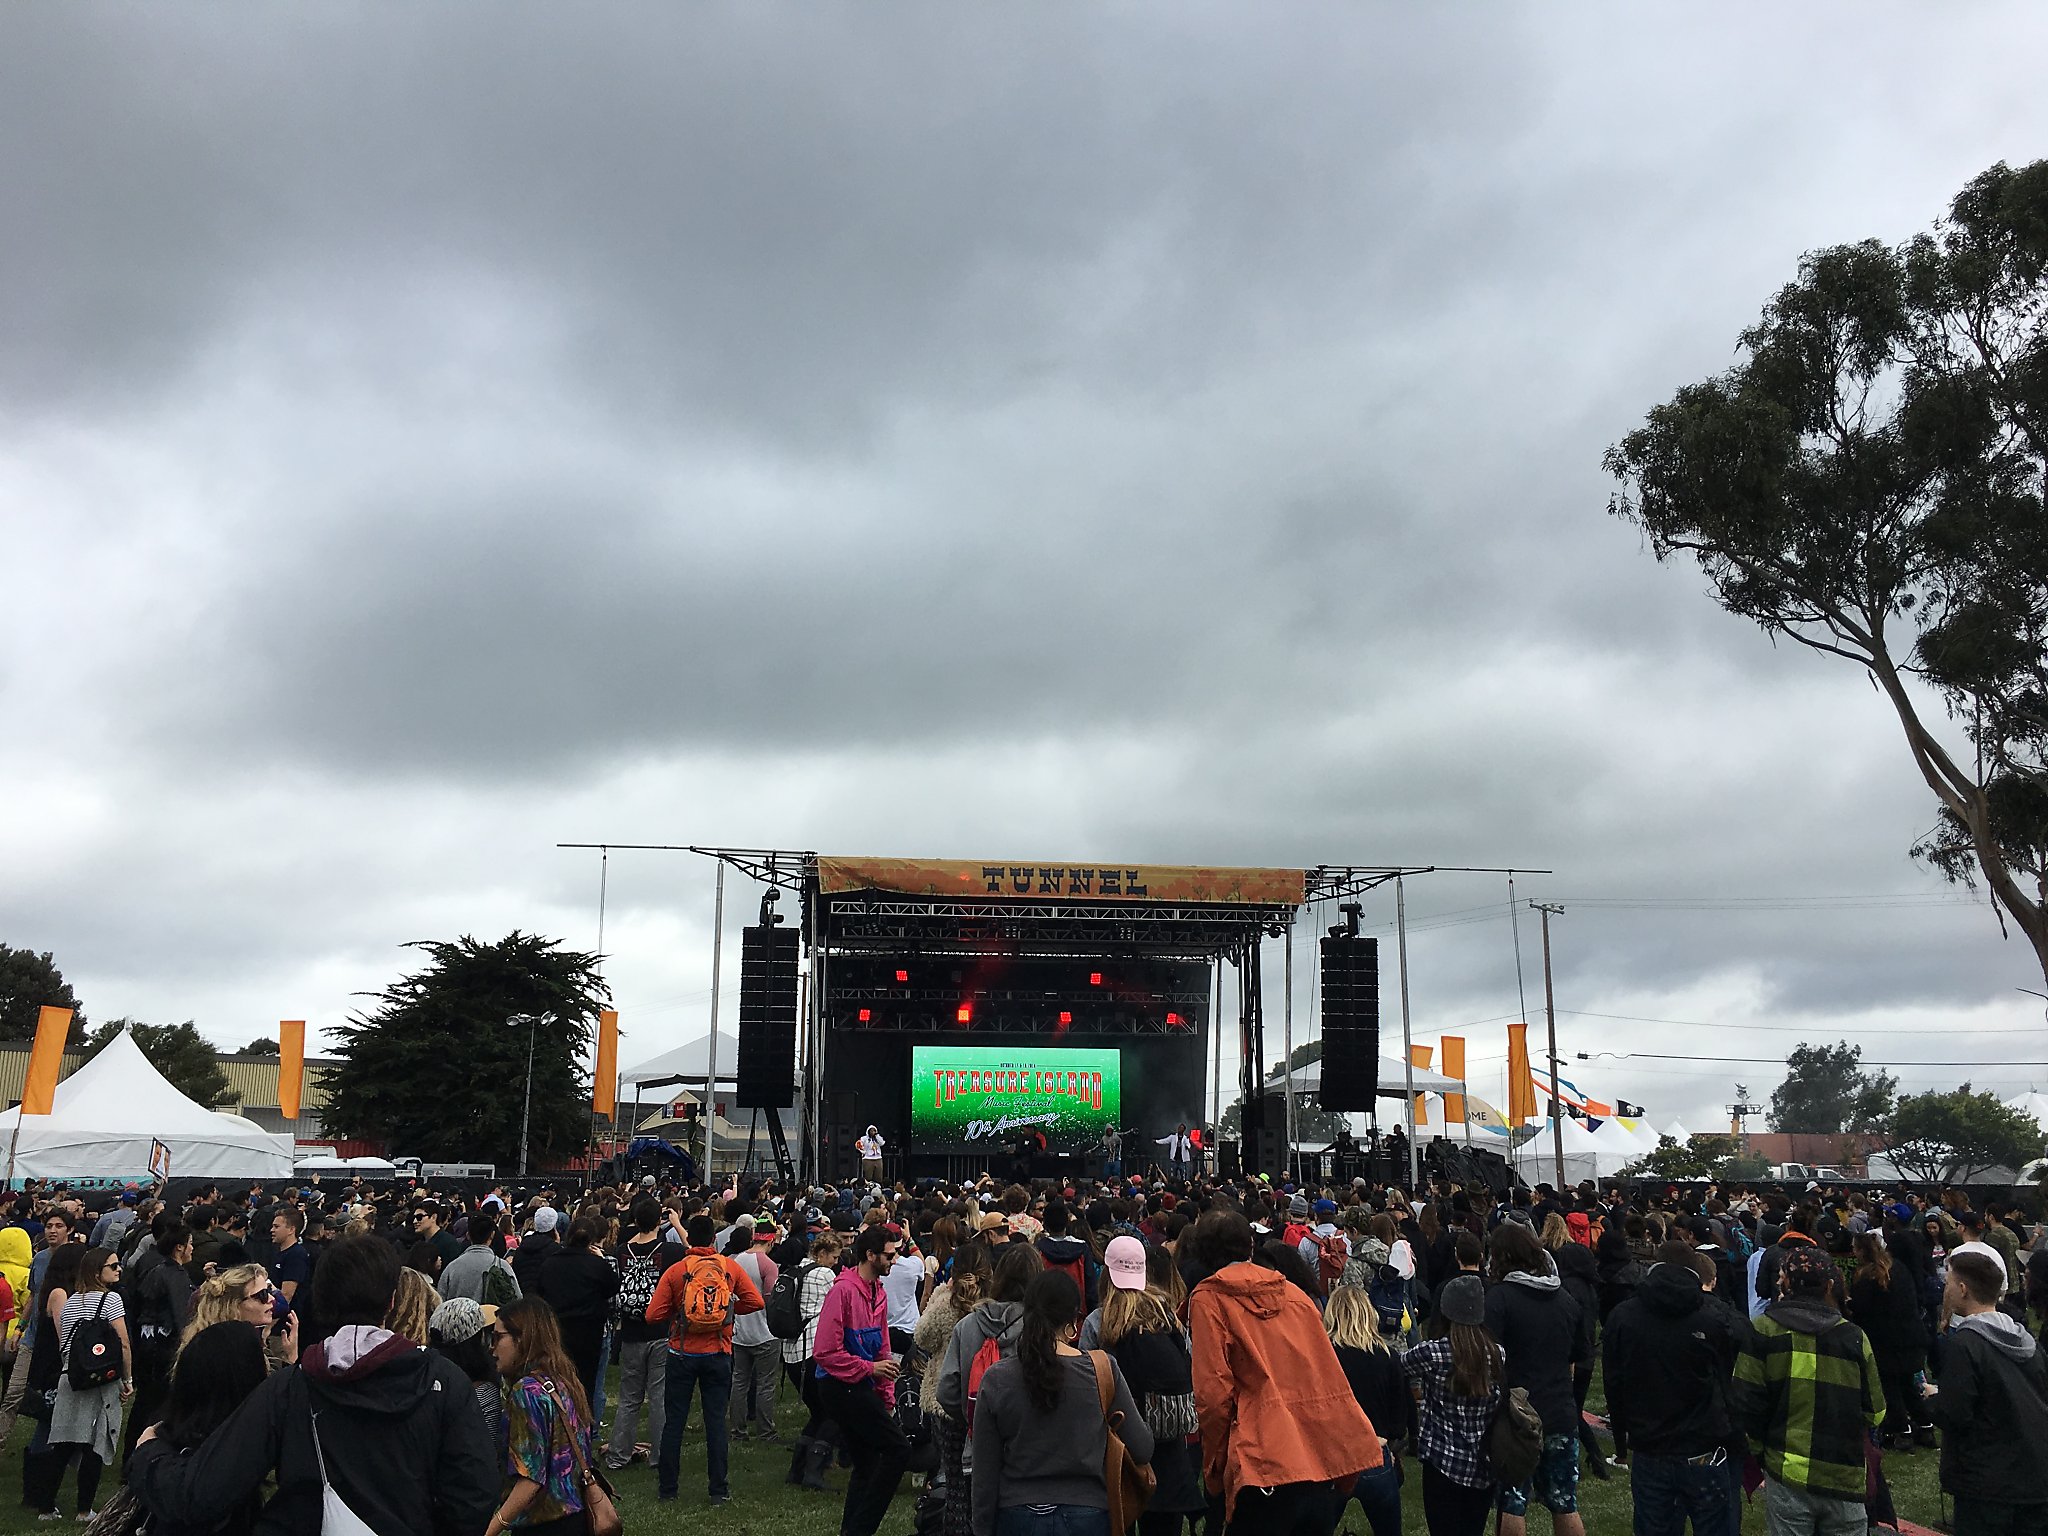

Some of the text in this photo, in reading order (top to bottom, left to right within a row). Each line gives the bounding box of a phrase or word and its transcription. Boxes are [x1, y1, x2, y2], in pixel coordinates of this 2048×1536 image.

[982, 866, 1148, 895] TUNNEL
[933, 1070, 1102, 1110] TREASURE ISLAND
[977, 1095, 1055, 1110] Music Festival
[966, 1111, 1060, 1141] 10th Anniversary
